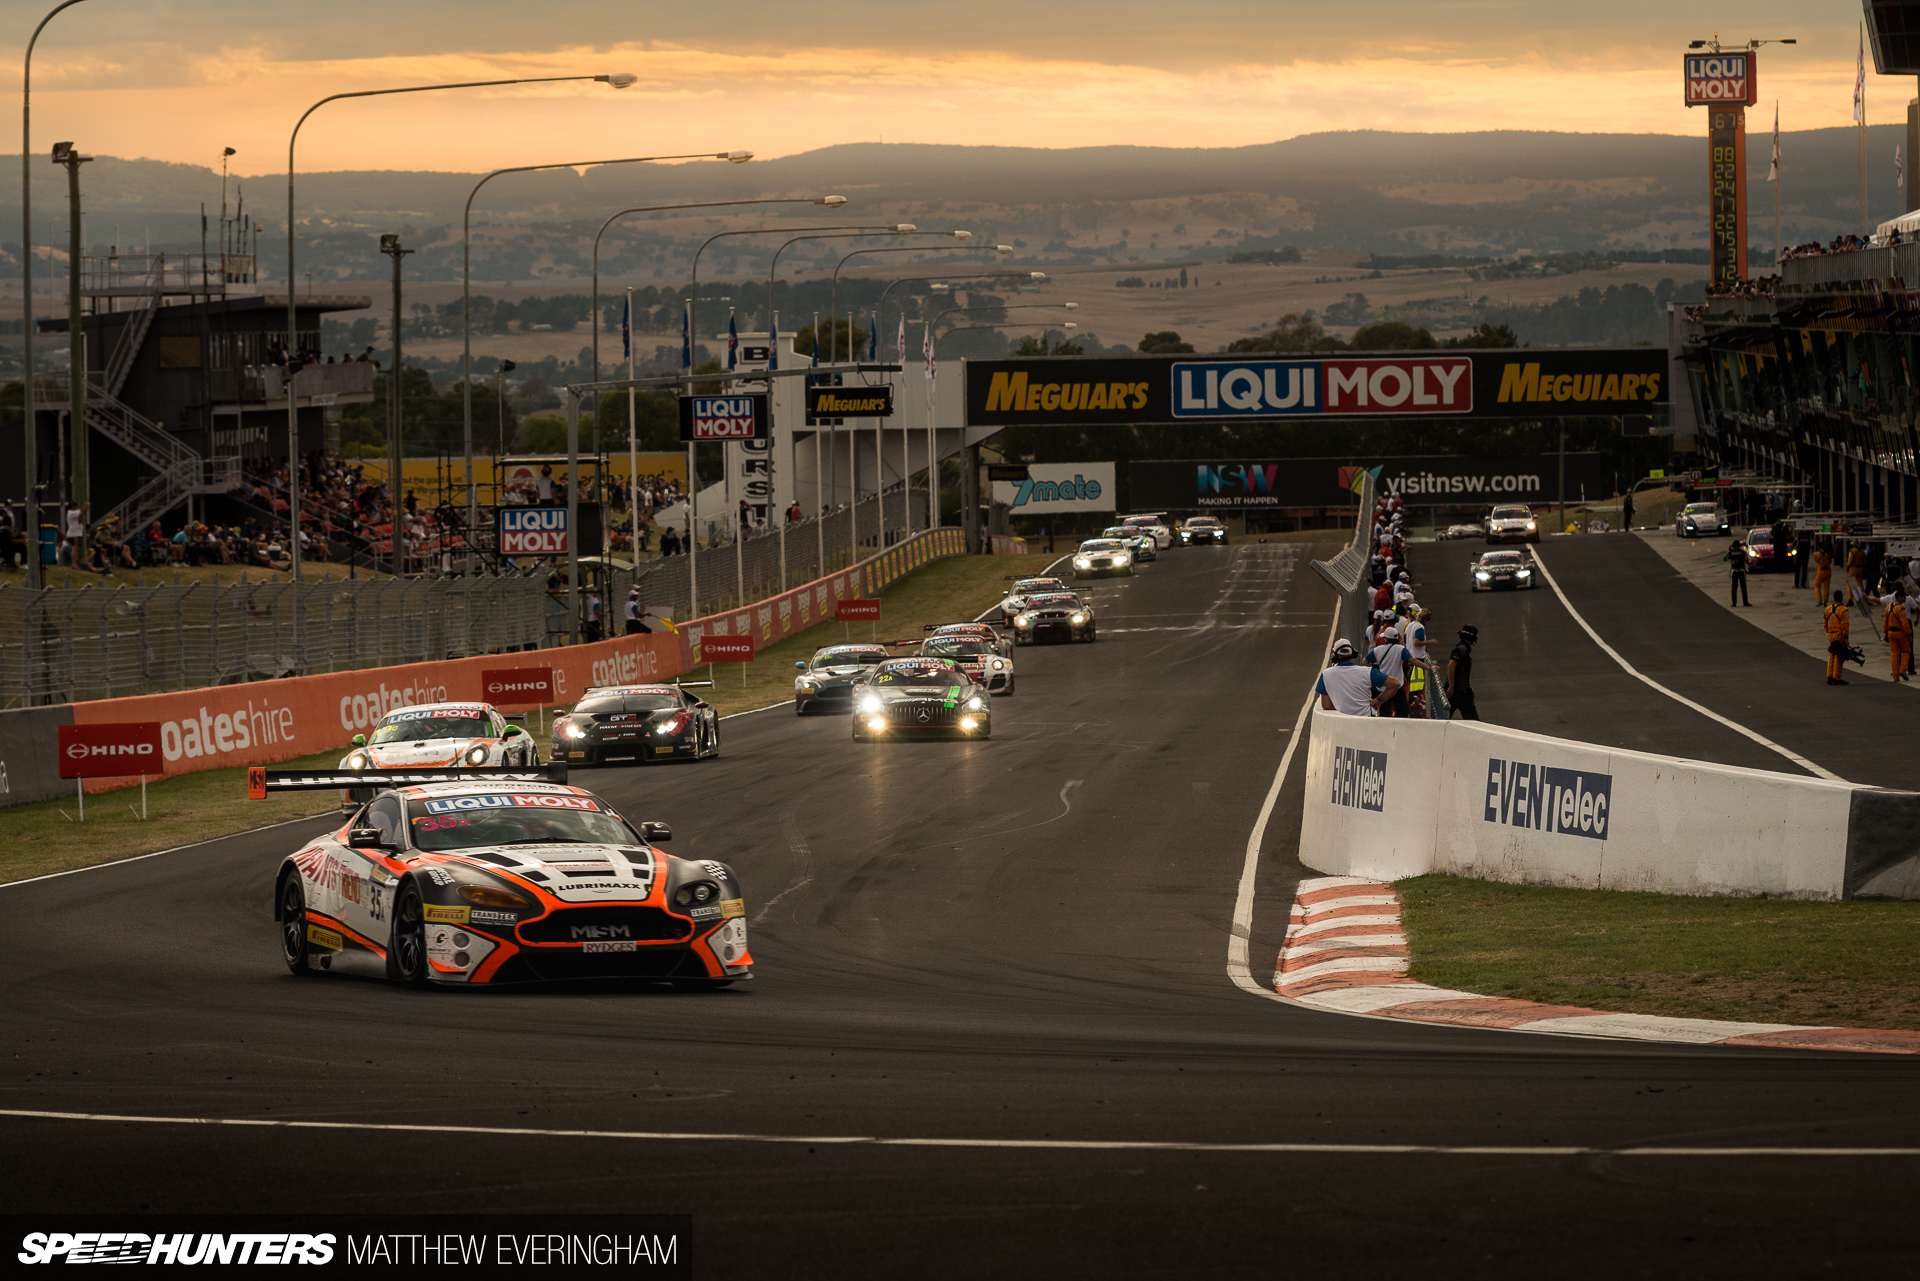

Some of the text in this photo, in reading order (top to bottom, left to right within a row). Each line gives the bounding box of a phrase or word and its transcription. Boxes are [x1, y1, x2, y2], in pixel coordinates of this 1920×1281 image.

[1690, 59, 1743, 79] LIQUI
[1690, 80, 1745, 99] MOLY
[1714, 164, 1735, 180] 22
[1715, 215, 1736, 230] 22
[985, 371, 1149, 411] MEGUIAR'S
[1181, 365, 1467, 411] LIQUI MOLY
[1497, 362, 1661, 403] MEGUIAR'S
[696, 399, 750, 418] LIQUI
[696, 419, 753, 437] MOLY
[1197, 464, 1278, 493] NSW
[1386, 471, 1540, 494] visitnsw.com
[1012, 474, 1102, 506] 7mate
[1243, 497, 1279, 505] HAPPEN
[504, 510, 564, 531] LIQUI
[504, 532, 567, 552] MOLY
[711, 645, 750, 653] HINO
[930, 637, 955, 645] LIQUI
[921, 663, 953, 671] MOLY
[504, 681, 548, 691] HINO
[390, 709, 479, 724] LIQUI MOLY
[92, 743, 153, 756] HINO
[429, 796, 595, 812] LIQUI MOLY
[1485, 758, 1608, 836] EVENTelec
[558, 883, 641, 891] LUBRIMAXX
[427, 907, 465, 920] PIRELLI
[312, 930, 341, 947] PIRELLI
[586, 942, 635, 953] RYDGES
